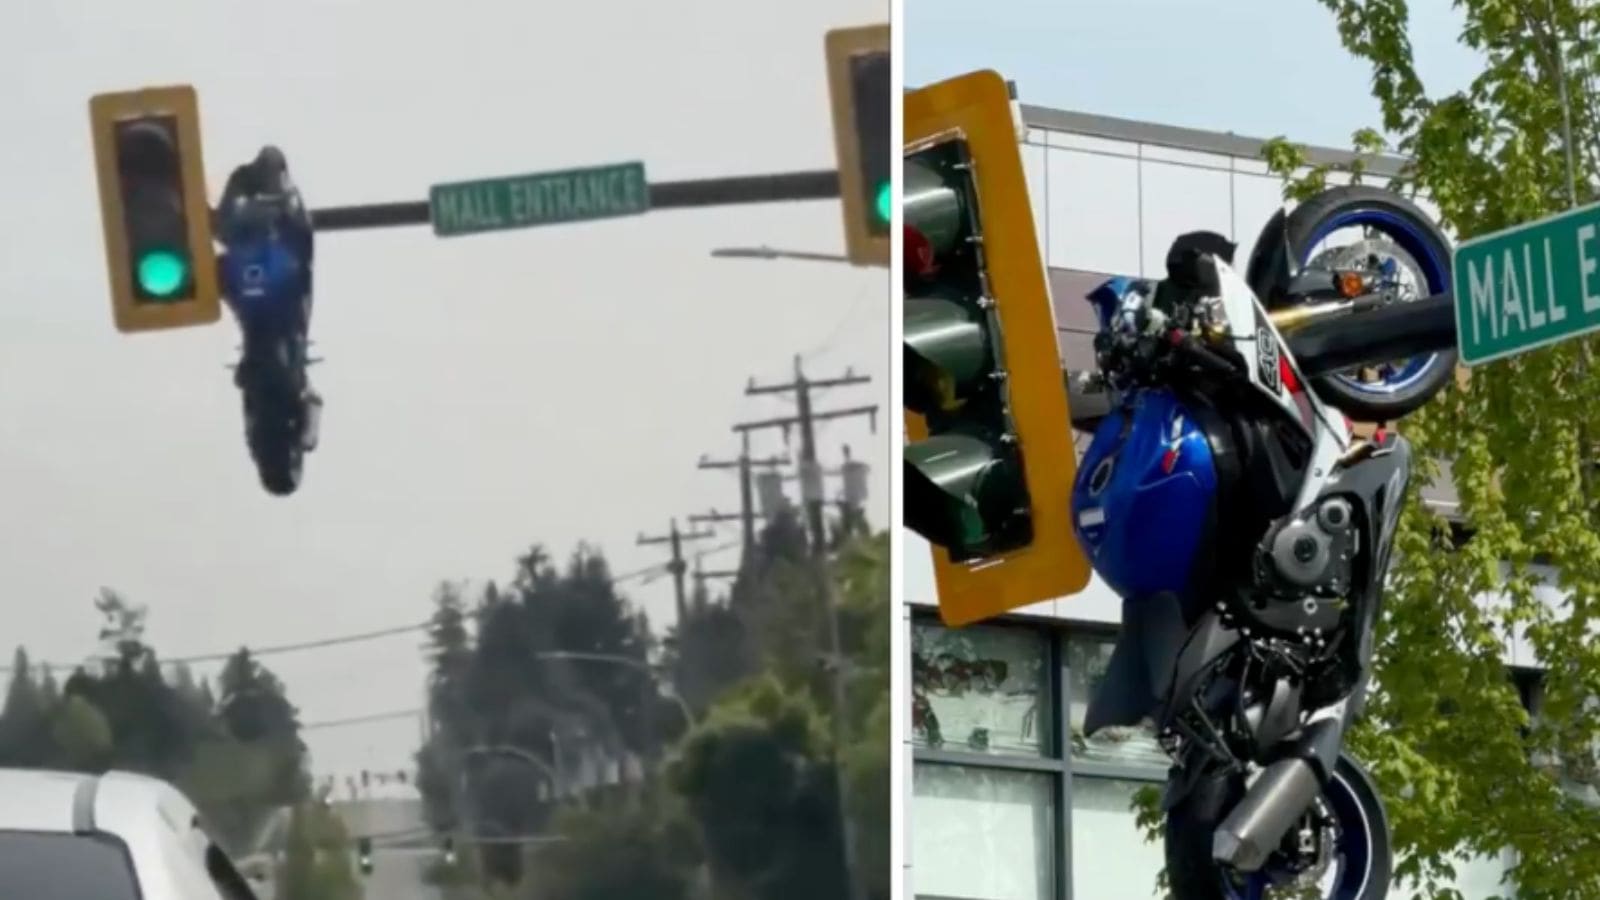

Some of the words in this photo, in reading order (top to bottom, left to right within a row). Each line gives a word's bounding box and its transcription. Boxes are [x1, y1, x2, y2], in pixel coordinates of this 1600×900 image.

[437, 186, 504, 230] MALL
[509, 168, 640, 221] ENTRANCE
[1467, 237, 1567, 345] MALL
